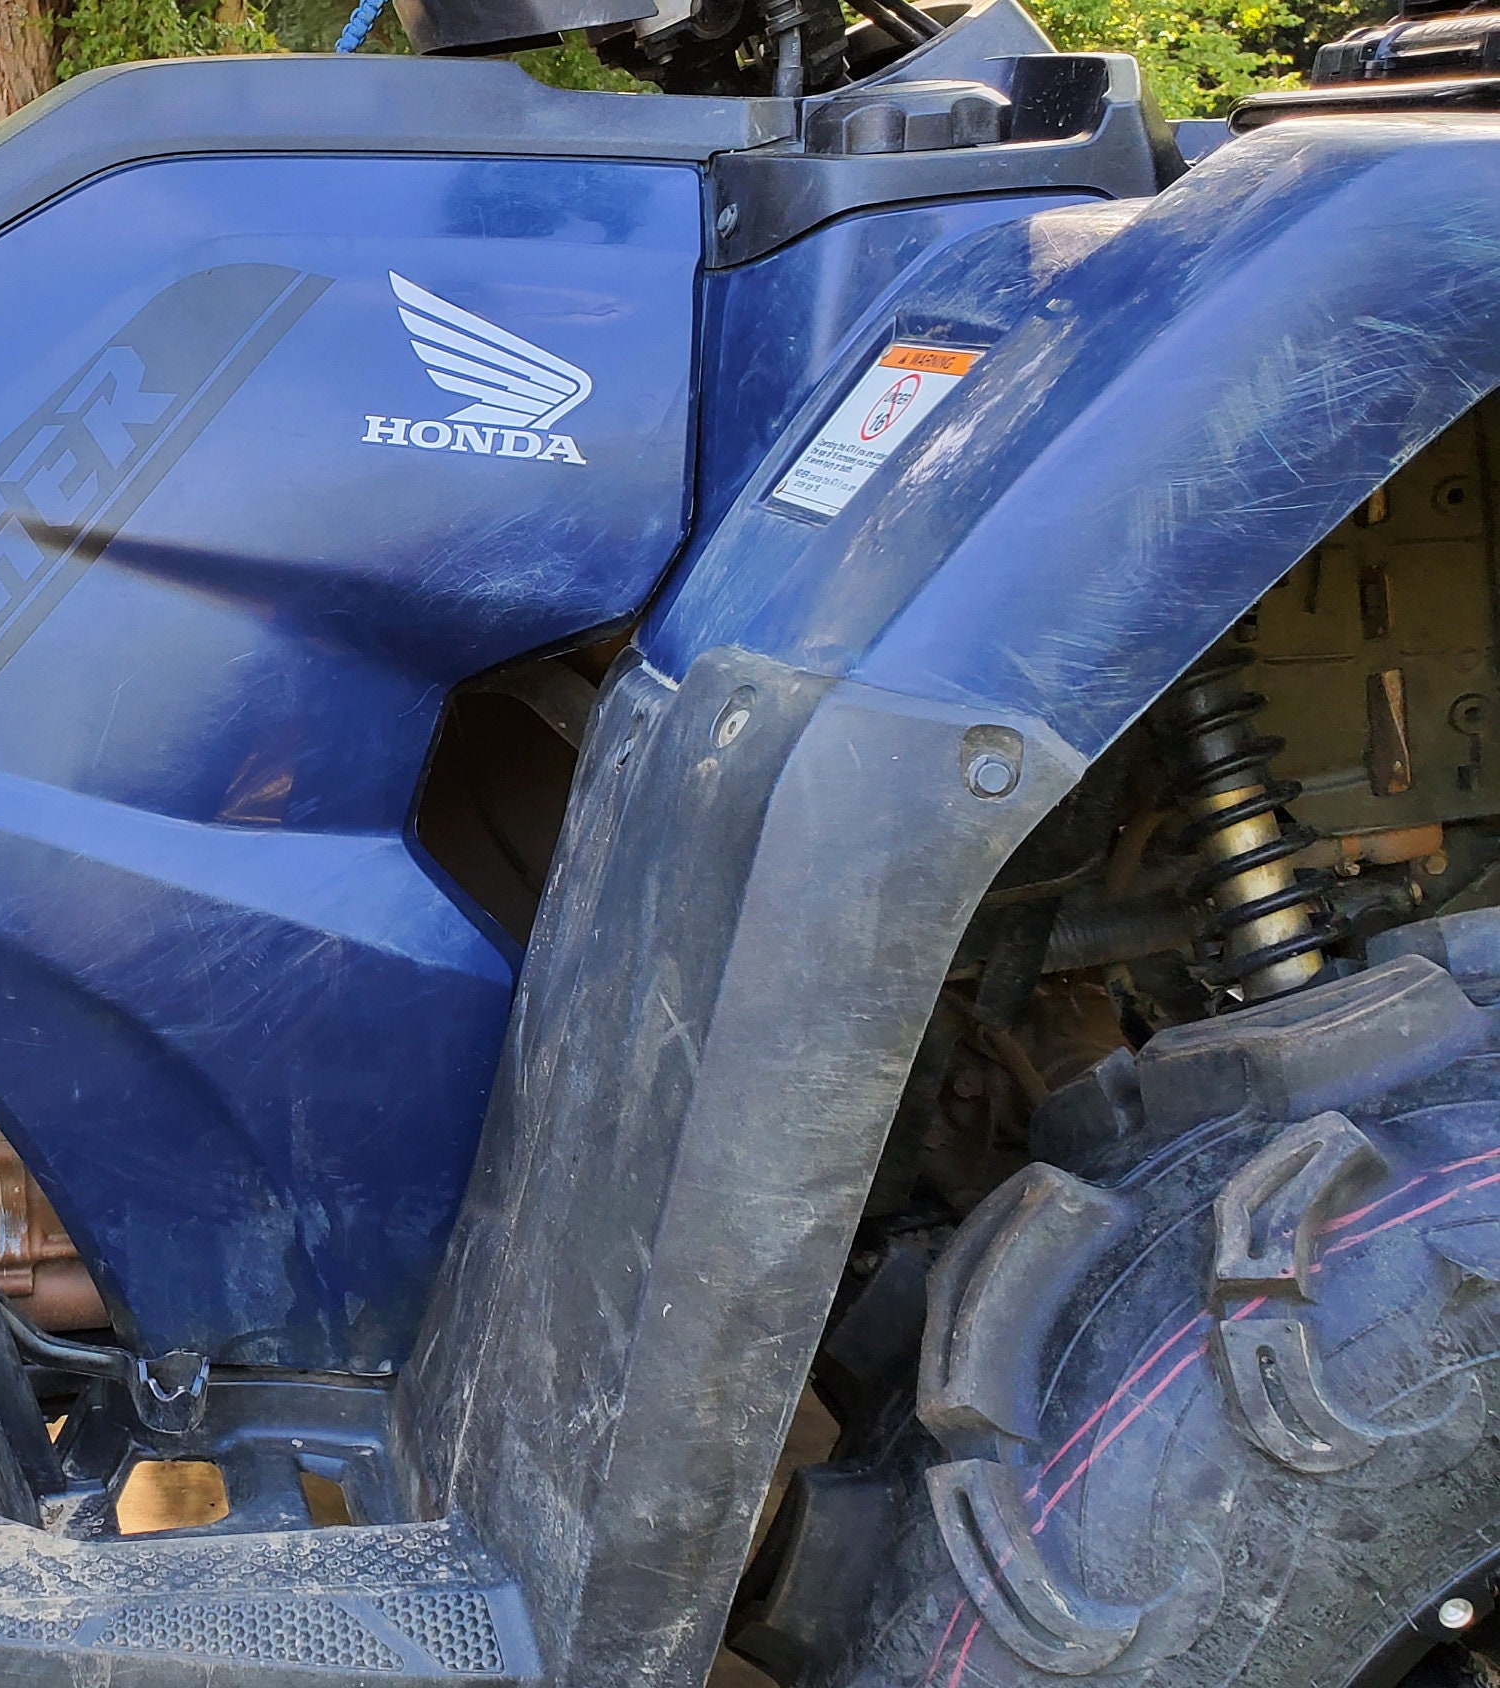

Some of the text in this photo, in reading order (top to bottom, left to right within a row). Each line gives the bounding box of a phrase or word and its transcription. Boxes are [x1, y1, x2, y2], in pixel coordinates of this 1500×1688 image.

[910, 352, 956, 370] WARNING
[868, 412, 890, 432] 16
[361, 414, 587, 465] HONDA
